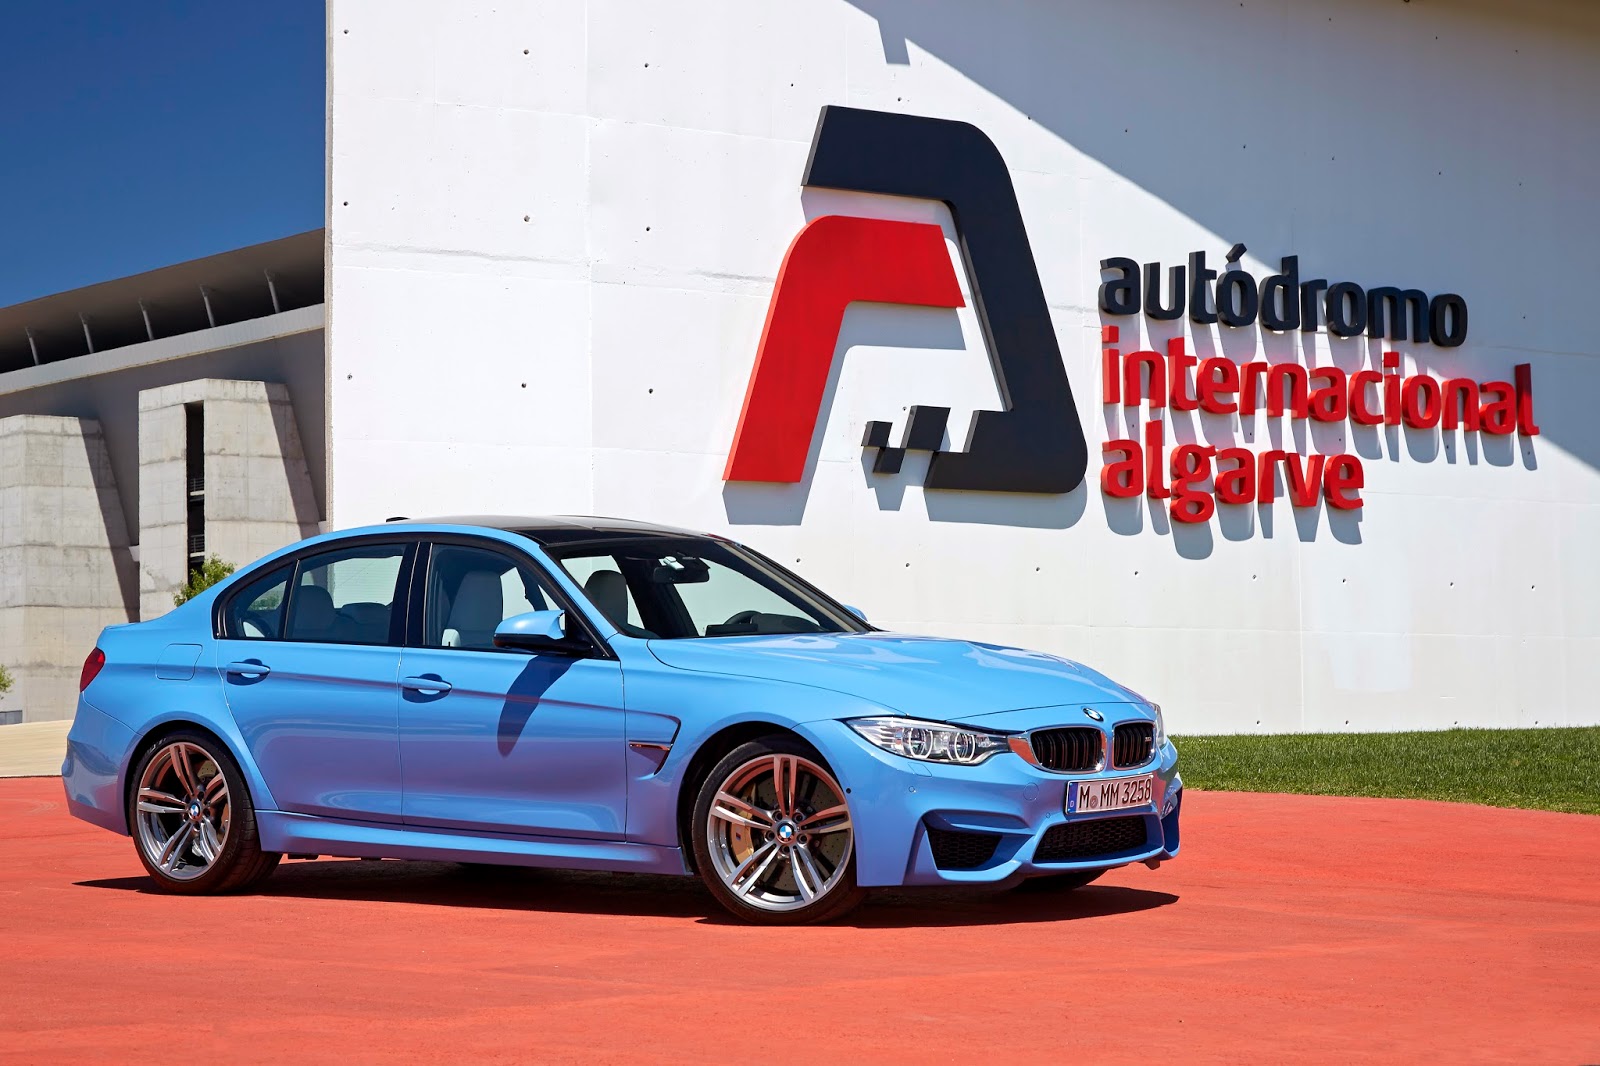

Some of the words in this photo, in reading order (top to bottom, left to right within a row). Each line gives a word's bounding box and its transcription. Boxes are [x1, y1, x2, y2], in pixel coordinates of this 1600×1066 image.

[1099, 243, 1468, 347] autódromo
[1101, 325, 1540, 436] internacional
[1101, 420, 1364, 523] algarve
[1079, 785, 1090, 808] M
[1100, 783, 1120, 807] MM
[1122, 778, 1151, 804] 3258
